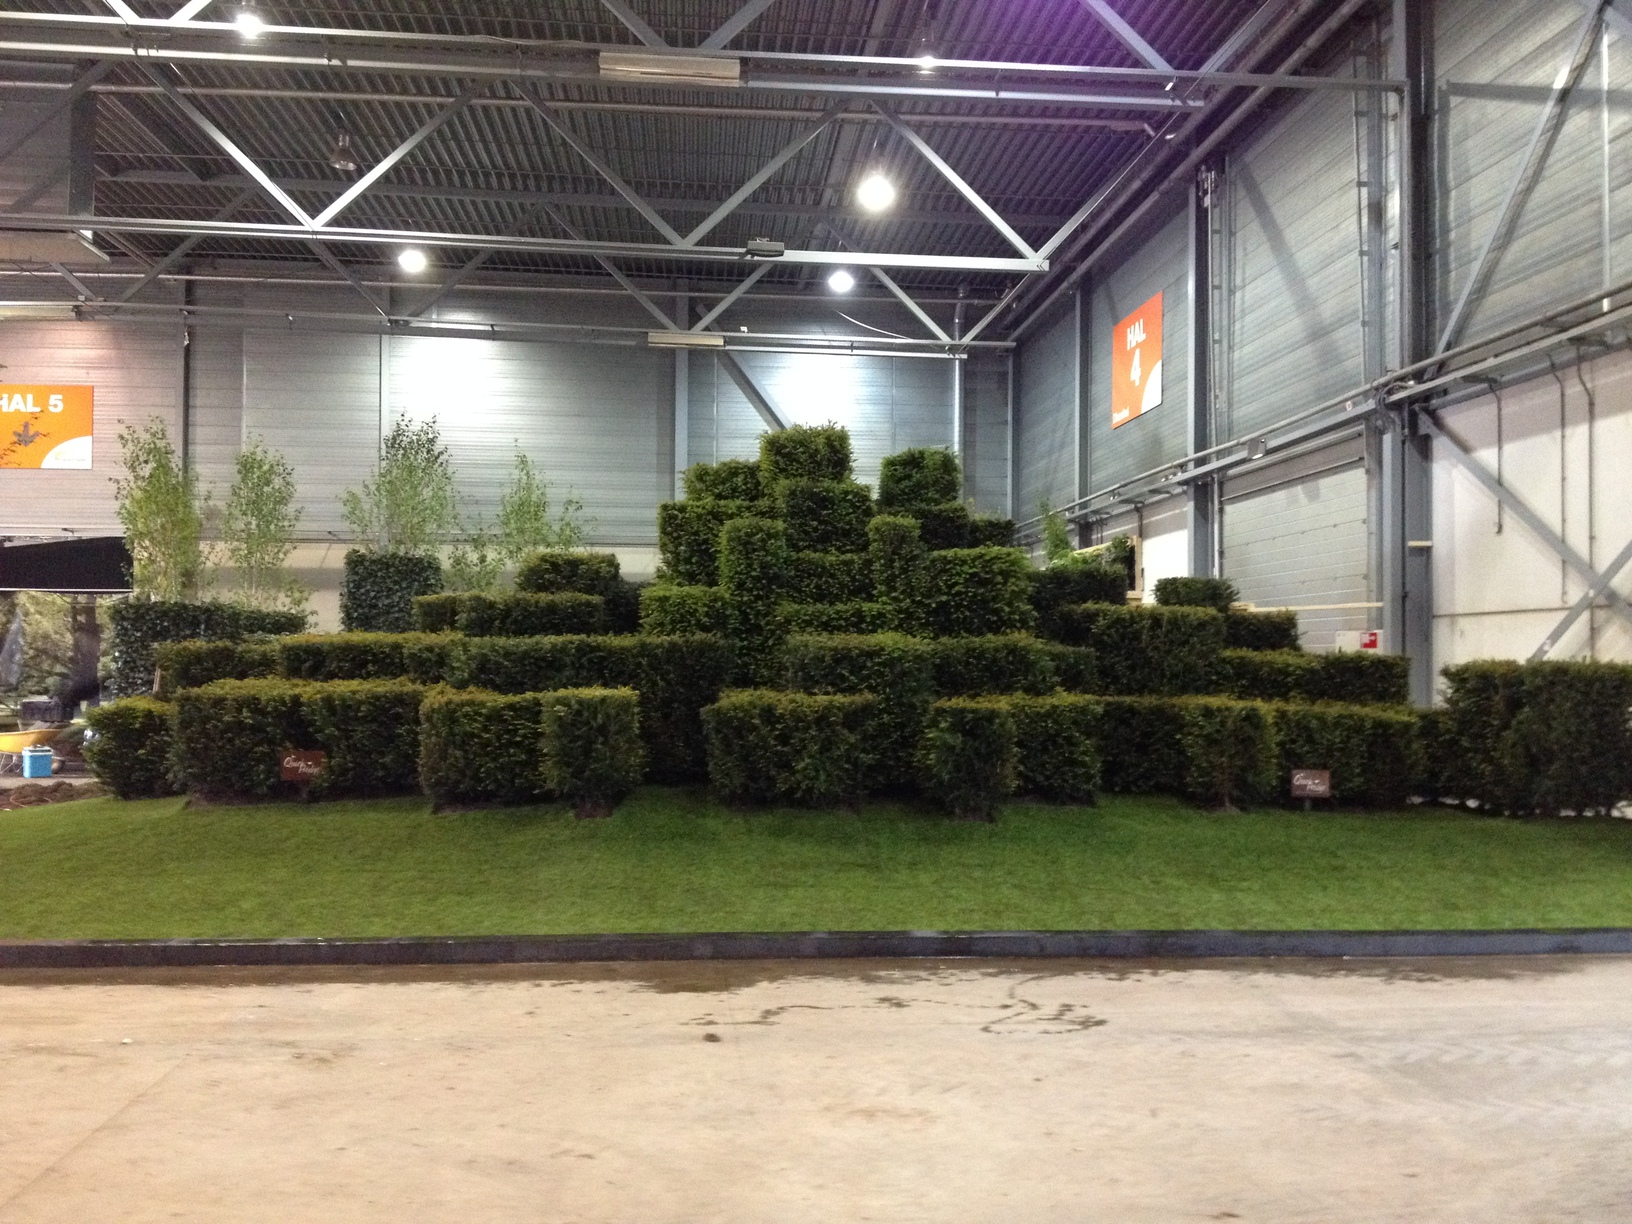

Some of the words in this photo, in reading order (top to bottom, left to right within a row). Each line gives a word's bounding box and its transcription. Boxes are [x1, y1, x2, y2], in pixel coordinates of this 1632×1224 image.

[1127, 319, 1146, 351] HAL
[1130, 348, 1141, 387] 4
[48, 394, 64, 412] 5
